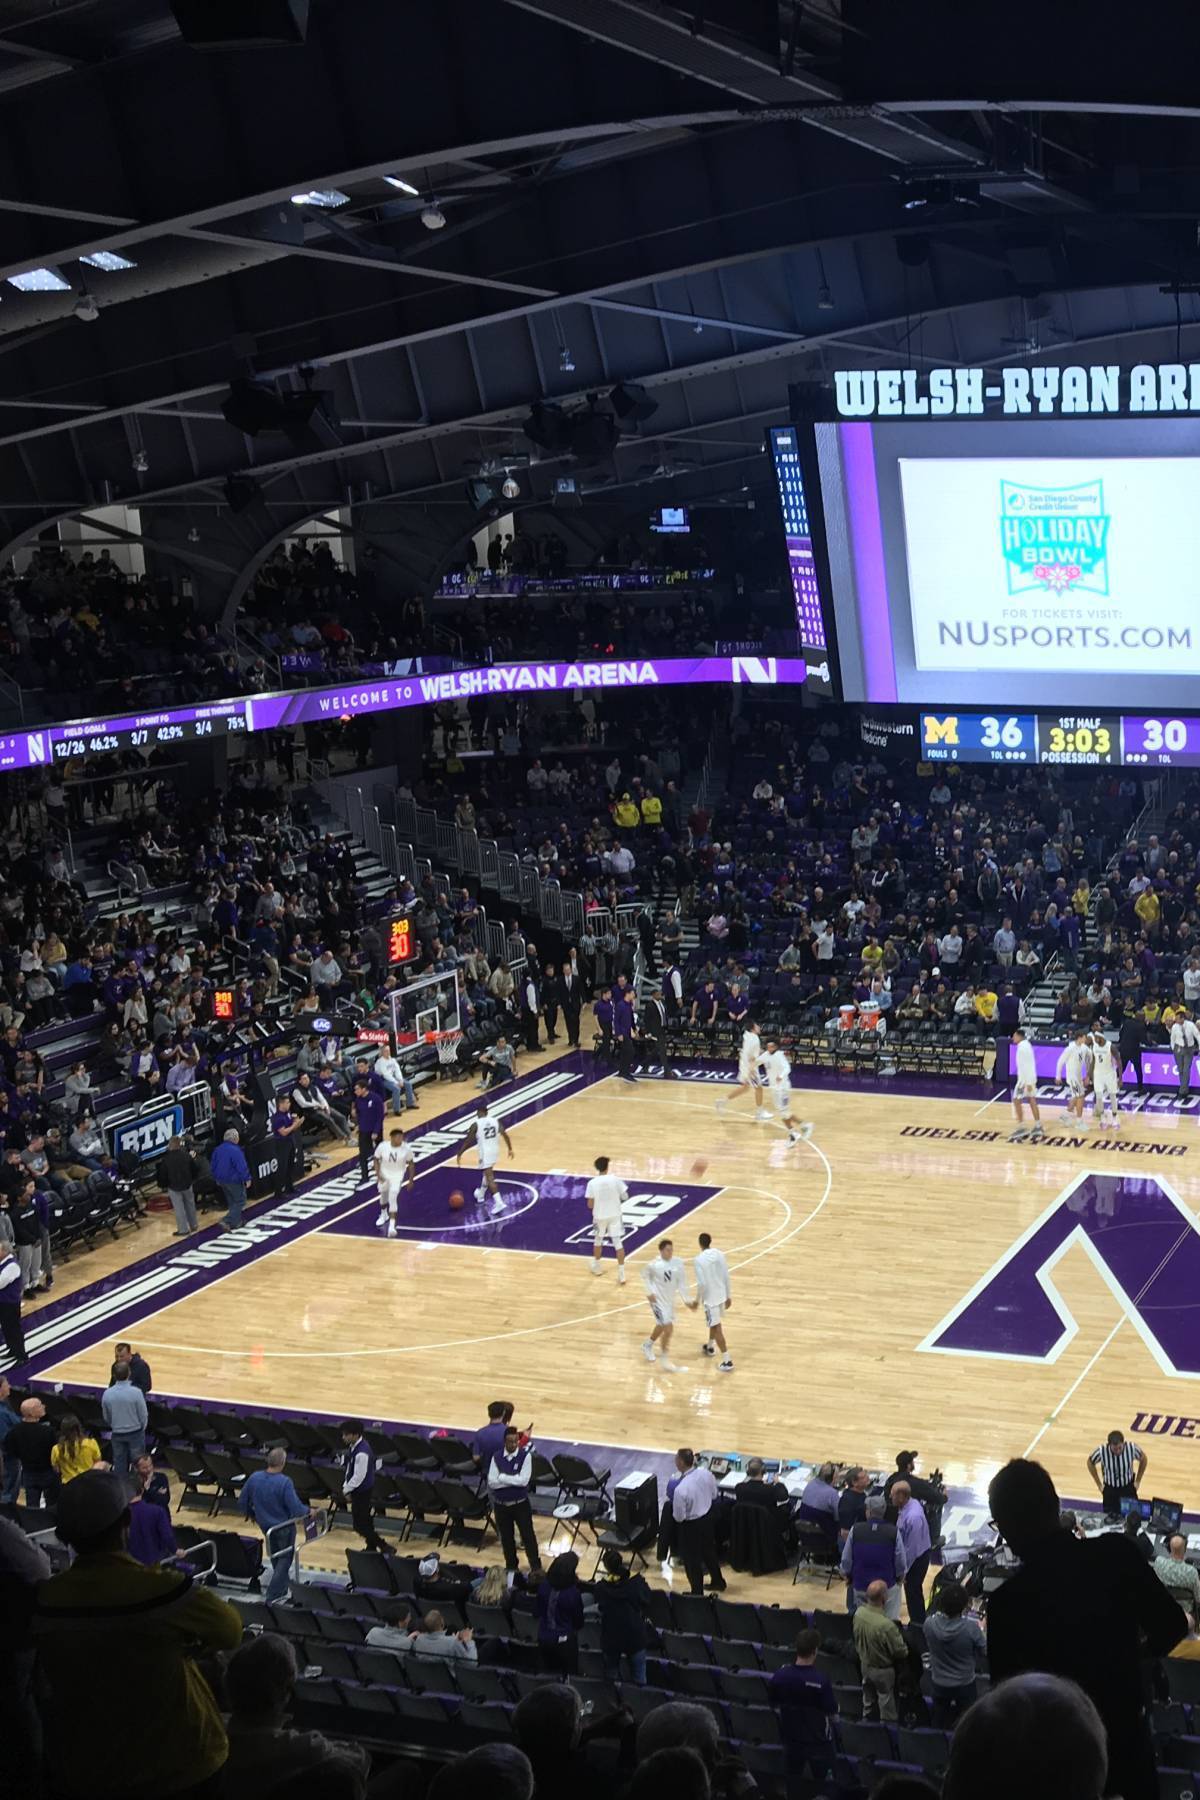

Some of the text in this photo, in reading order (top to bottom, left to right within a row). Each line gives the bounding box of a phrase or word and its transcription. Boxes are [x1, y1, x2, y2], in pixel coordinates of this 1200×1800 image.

[834, 365, 1120, 416] WELSH-RYAN
[1069, 494, 1097, 504] County
[1005, 517, 1106, 548] HOLIDAY
[1023, 548, 1092, 563] BOWL
[1003, 609, 1122, 620] FOR TICKETS VISIT:
[731, 657, 777, 683] N
[319, 661, 659, 713] WELCOME TO WELSH-RYAN ARENA
[196, 715, 245, 735] 3/4 75%
[924, 716, 960, 744] M
[980, 717, 1023, 748] 36
[1059, 718, 1101, 729] 1ST HALF
[131, 725, 183, 745] 3/7 42.9%
[1050, 727, 1111, 753] 3:03
[1143, 720, 1187, 751] 30
[27, 733, 45, 764] N
[55, 735, 119, 757] 12/26 46.2%
[928, 750, 958, 760] FOULS 0
[991, 751, 1003, 760] TOL
[1042, 752, 1100, 764] POSSESSION
[1158, 755, 1172, 764] TOL
[392, 919, 409, 936] 3:03
[389, 934, 408, 962] 30
[121, 1115, 175, 1152] BTN
[484, 1127, 496, 1139] 23
[388, 1151, 397, 1163] N
[1090, 1139, 1188, 1157] ARENA
[258, 1157, 279, 1179] me
[664, 1271, 672, 1282] N
